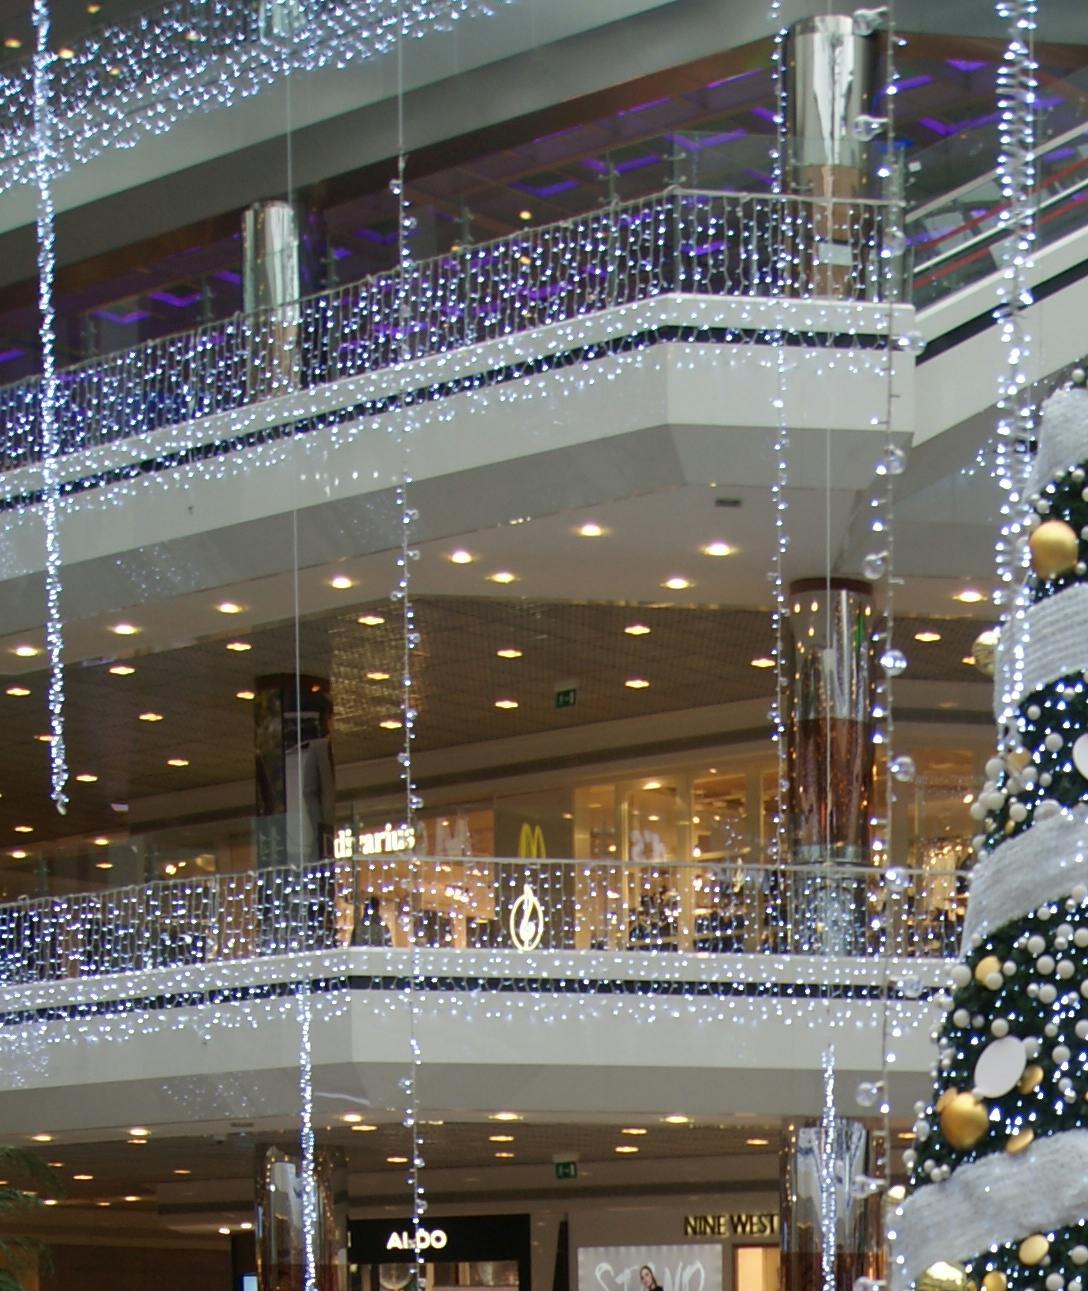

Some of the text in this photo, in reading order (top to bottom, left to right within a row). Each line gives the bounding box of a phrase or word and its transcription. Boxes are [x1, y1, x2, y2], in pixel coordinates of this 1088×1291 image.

[684, 1214, 779, 1236] NINE WEST
[386, 1229, 448, 1250] ALDO
